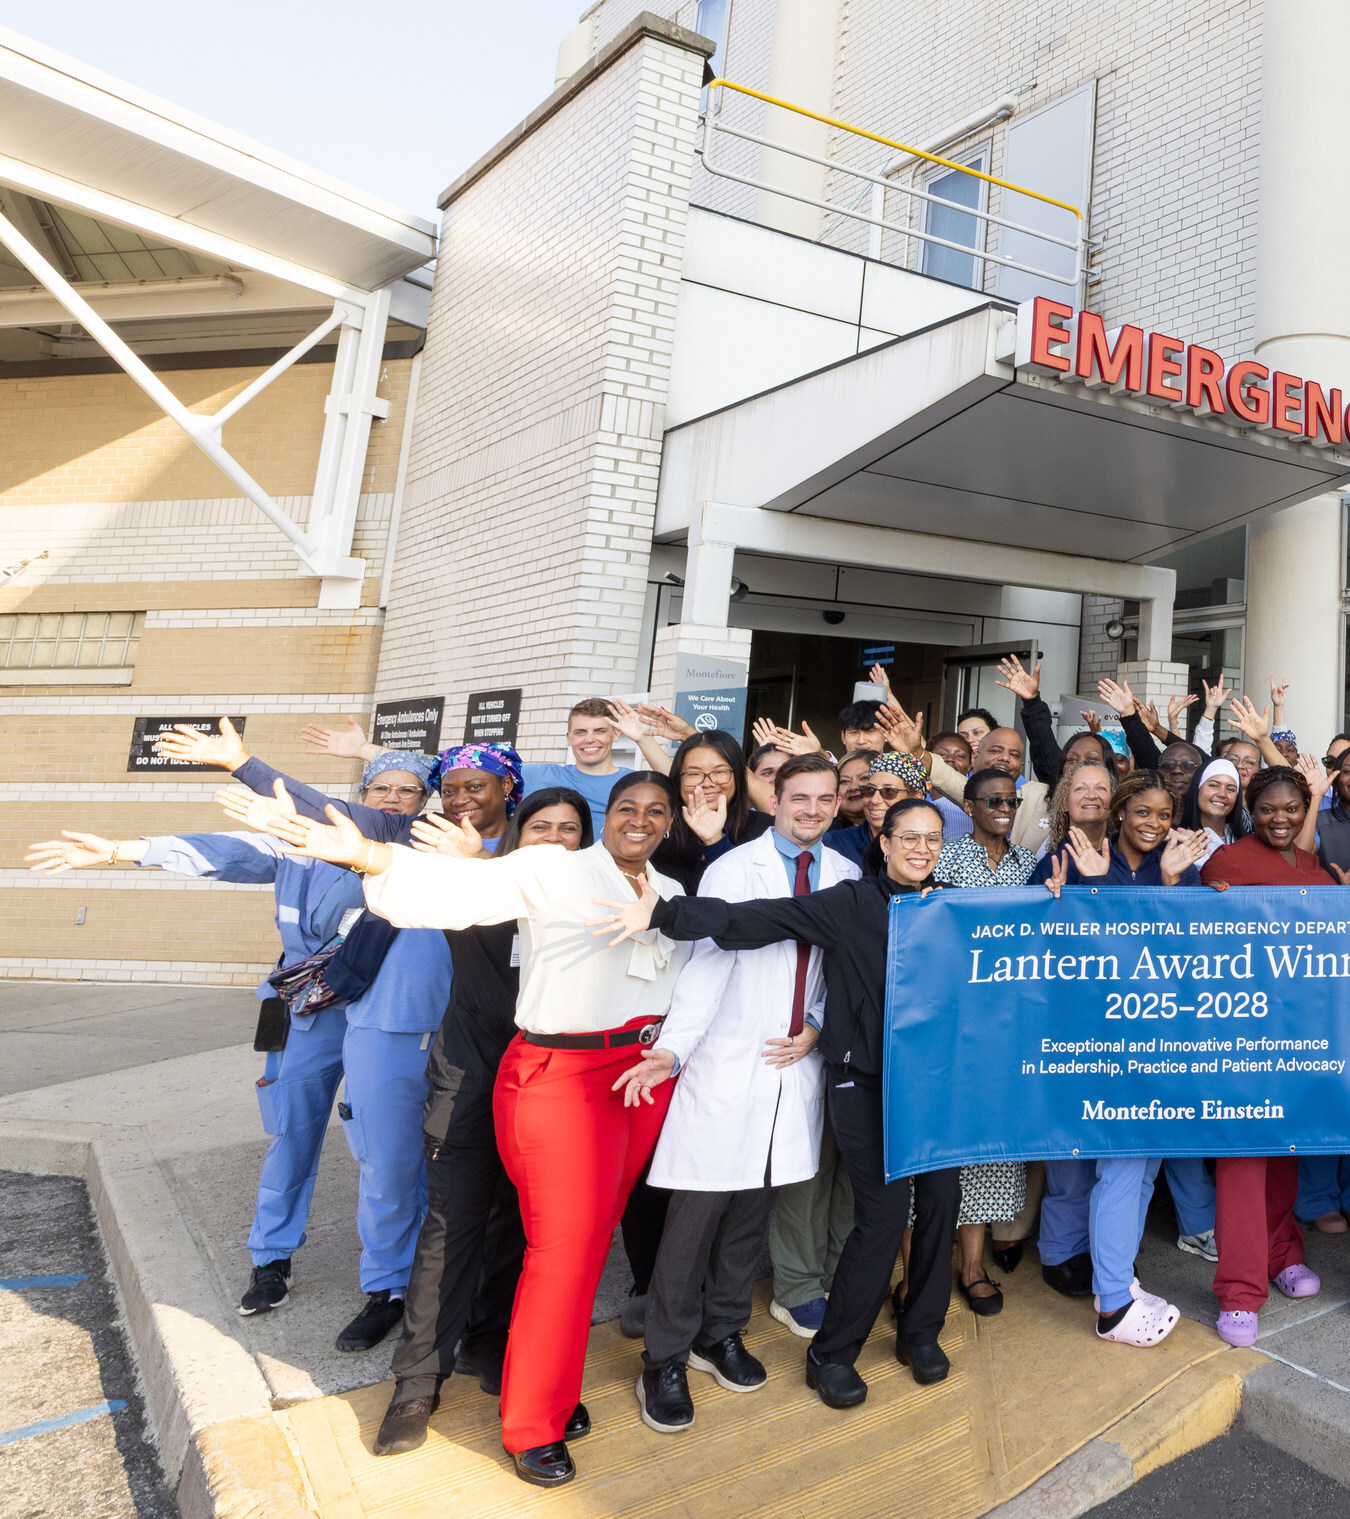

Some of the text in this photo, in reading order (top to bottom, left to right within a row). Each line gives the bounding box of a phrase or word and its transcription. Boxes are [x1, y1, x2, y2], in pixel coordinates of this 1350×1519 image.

[686, 668, 736, 679] Montefiore
[486, 700, 505, 709] VEHICLES
[377, 708, 439, 727] Emergency Ambulances Only
[486, 714, 502, 723] TURNED
[502, 713, 511, 722] OFF
[484, 728, 504, 737] STOPPING
[136, 757, 149, 765] DO
[150, 757, 169, 765] NOT
[971, 924, 1015, 939] JACK
[1019, 923, 1035, 936] D.
[1040, 922, 1100, 936] WEILER
[1105, 922, 1184, 935] HOSPITAL
[1189, 921, 1291, 935] EMERGENCY
[967, 949, 1121, 983] Lantern
[1129, 943, 1255, 980] Award
[1105, 991, 1269, 1019] 2025–2028
[1041, 1036, 1329, 1056] Exceptional and Innovative Performance
[1022, 1057, 1346, 1077] in Leadership, Practice and Patient Advocacy
[1081, 1098, 1285, 1120] Montefiore Einstein
